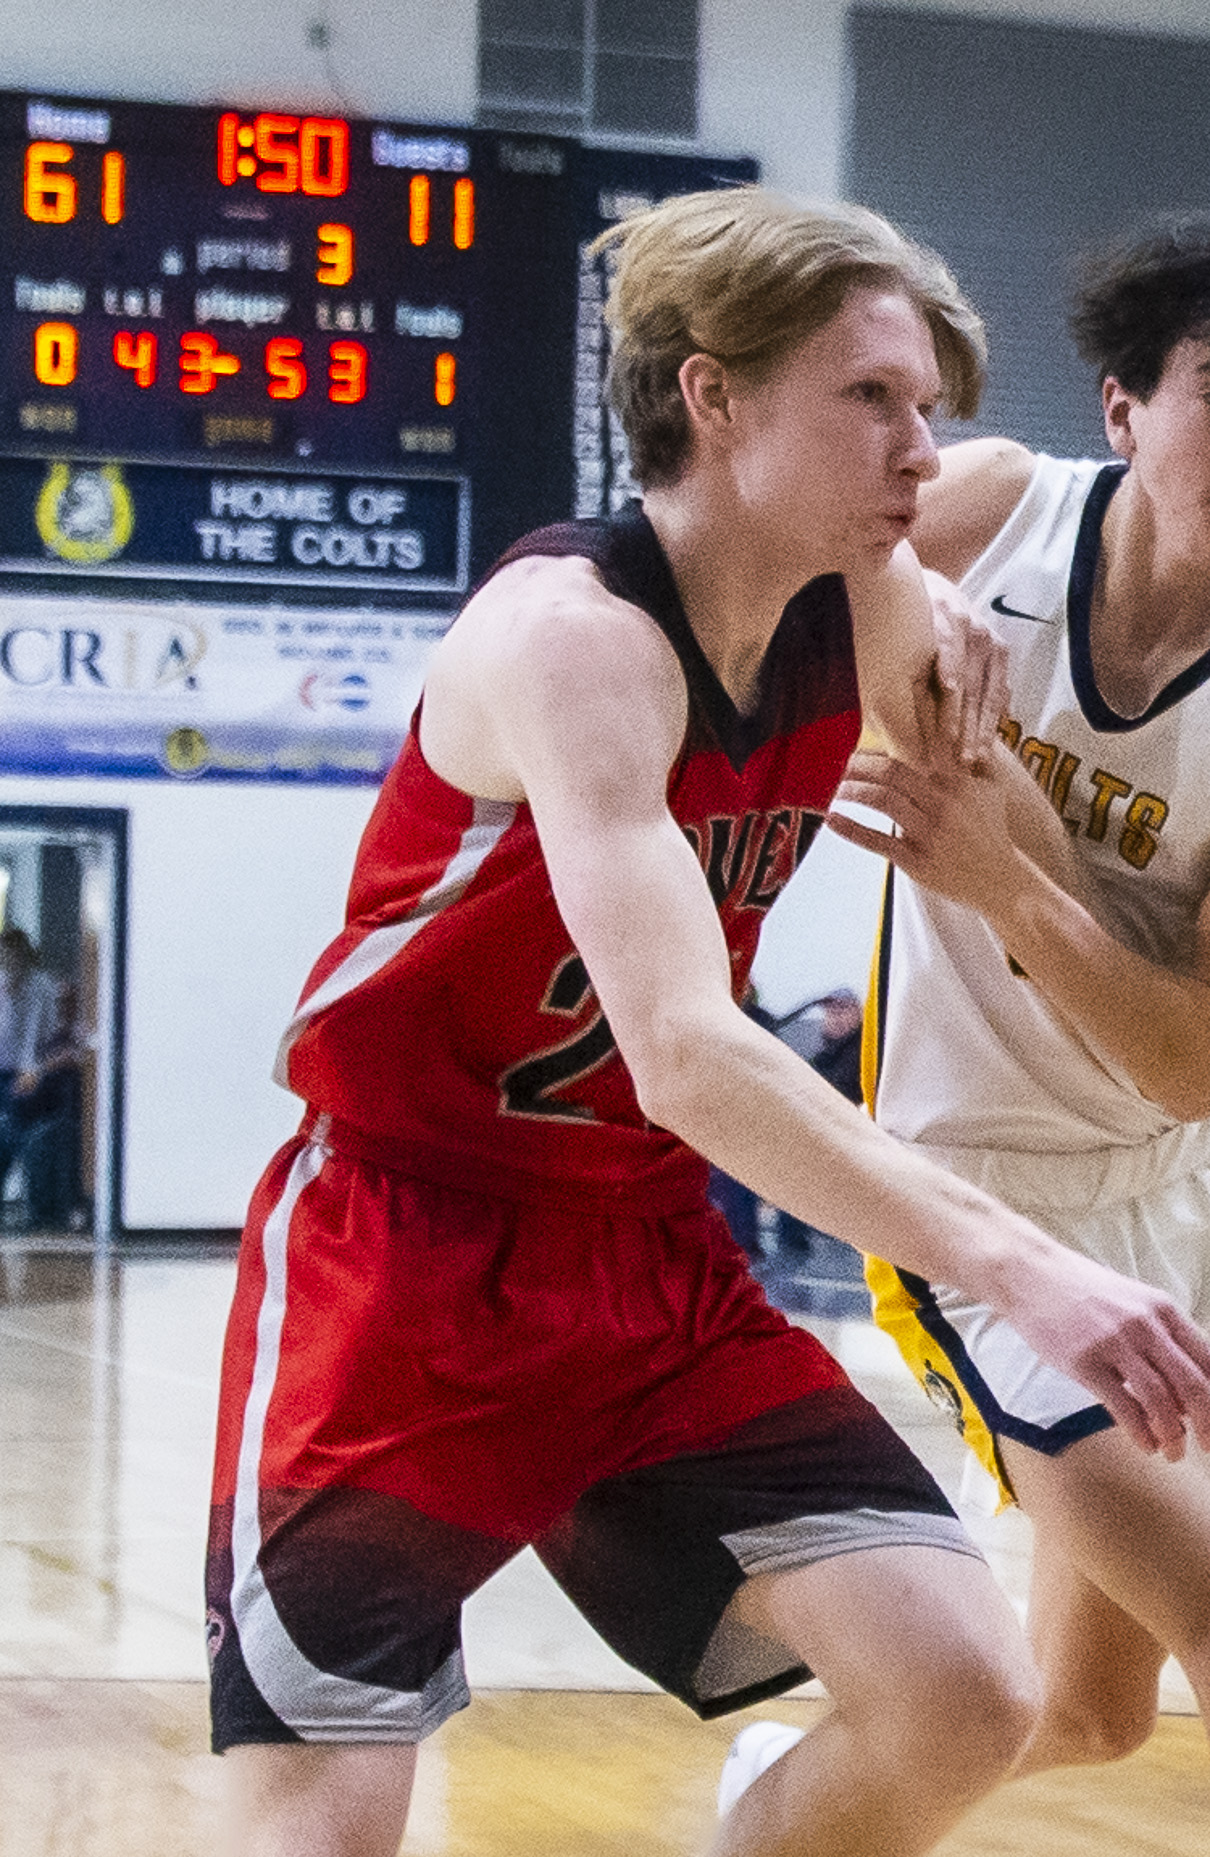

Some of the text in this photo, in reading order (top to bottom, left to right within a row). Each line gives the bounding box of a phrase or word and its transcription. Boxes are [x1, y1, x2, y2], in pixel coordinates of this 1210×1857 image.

[24, 141, 125, 224] 61
[217, 112, 349, 197] 1:50
[409, 174, 475, 249] 11
[316, 223, 355, 286] 3
[34, 321, 78, 386] 0
[113, 331, 158, 388] 4
[265, 336, 308, 400] 5
[328, 340, 368, 404] 3
[434, 352, 456, 406] 1
[211, 480, 405, 524] HOME OF
[196, 520, 425, 570] THE COLTS
[681, 804, 827, 912] VE
